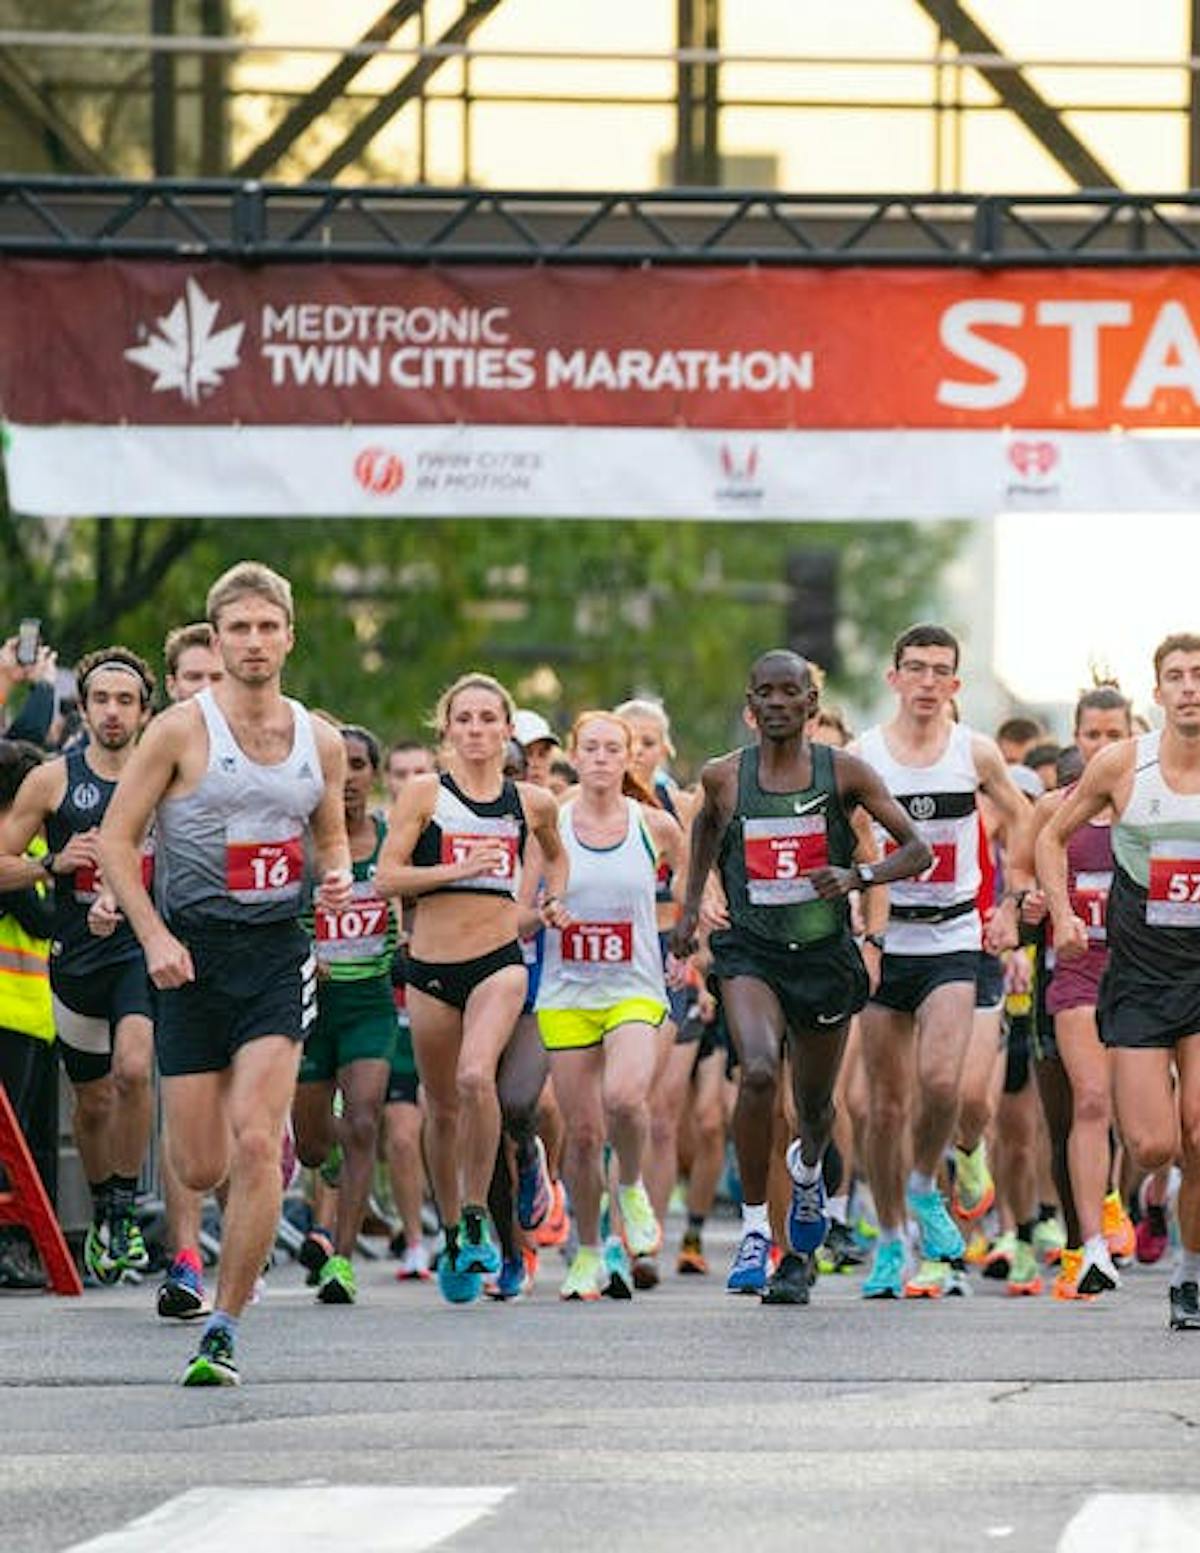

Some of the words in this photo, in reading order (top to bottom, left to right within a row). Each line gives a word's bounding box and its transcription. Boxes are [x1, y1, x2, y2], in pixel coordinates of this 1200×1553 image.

[261, 304, 510, 343] MEDTRONIC
[261, 343, 381, 388] TWIN
[390, 346, 536, 390] CITIES
[546, 348, 813, 391] MARATHON
[250, 855, 289, 889] 16
[452, 847, 510, 876] 13
[776, 850, 798, 879] 5
[324, 909, 382, 940] 107
[571, 933, 624, 962] 118
